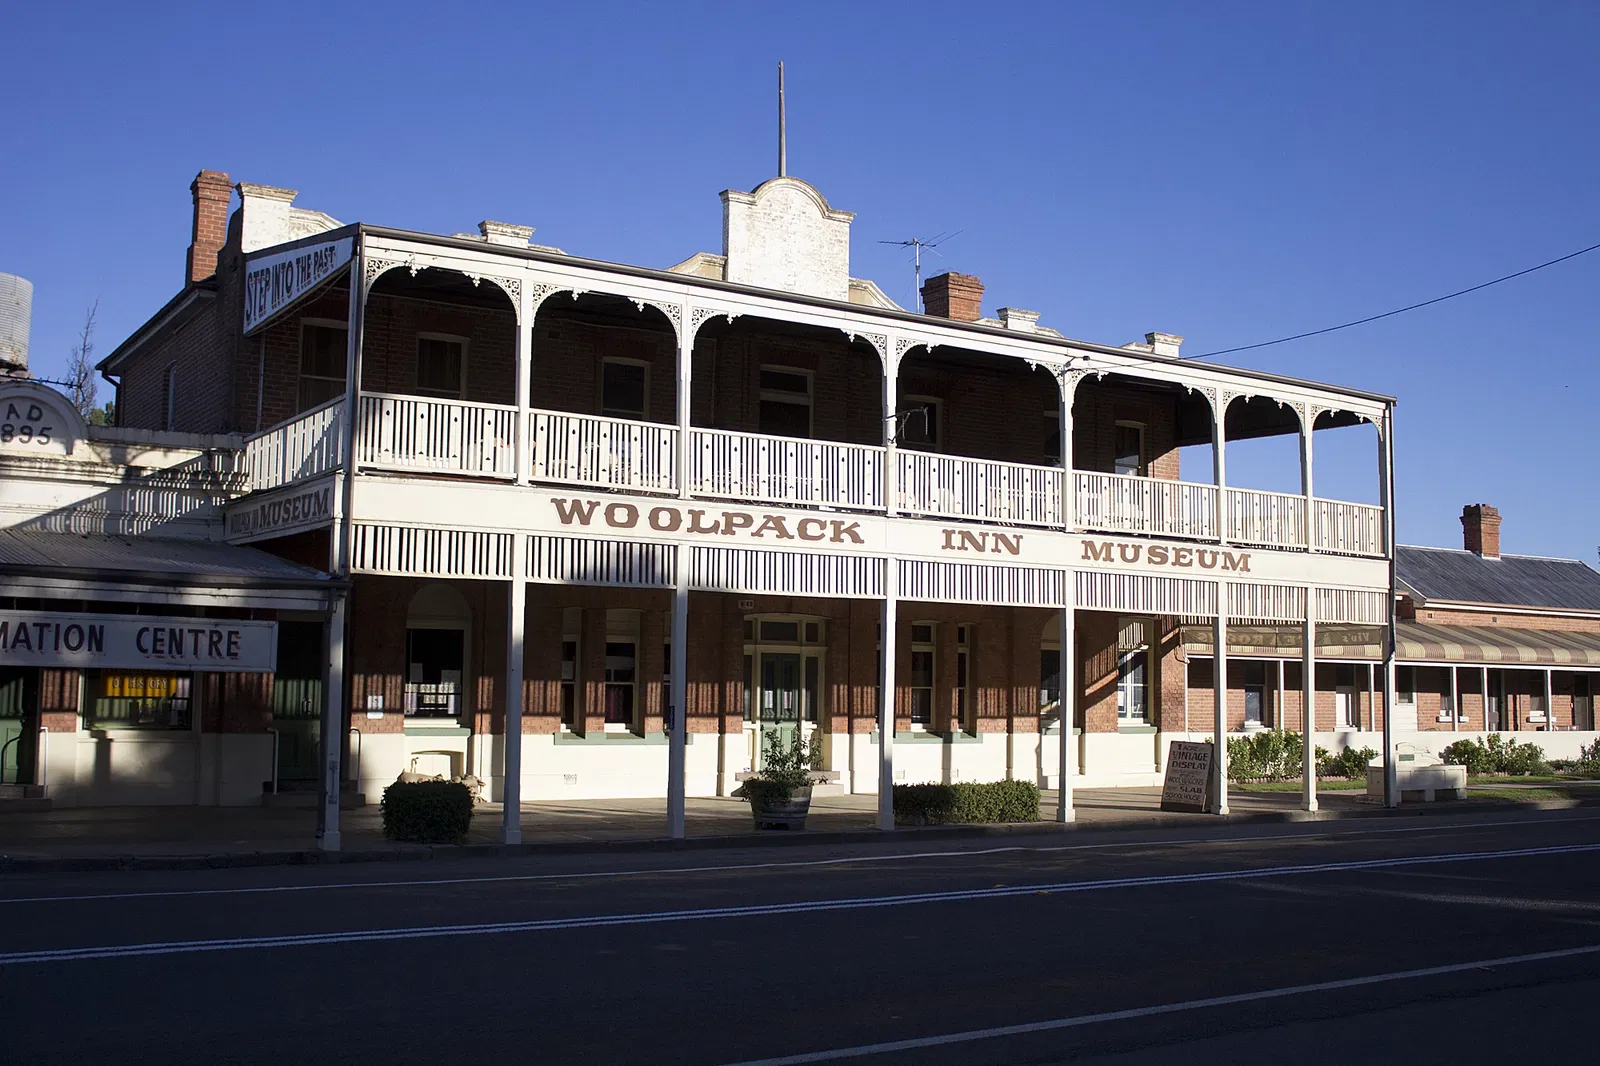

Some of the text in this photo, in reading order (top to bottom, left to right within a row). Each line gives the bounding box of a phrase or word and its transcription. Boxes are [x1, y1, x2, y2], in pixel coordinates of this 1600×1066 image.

[245, 245, 336, 326] STEP INTO THE PAST
[259, 487, 330, 529] MUSEUM
[551, 496, 1252, 573] WOOLPACK INN MUSEUM
[136, 626, 241, 659] CENTRE
[1172, 751, 1208, 762] VINTAGE
[1172, 760, 1208, 770] DISPLAY
[1179, 786, 1202, 794] SLAB
